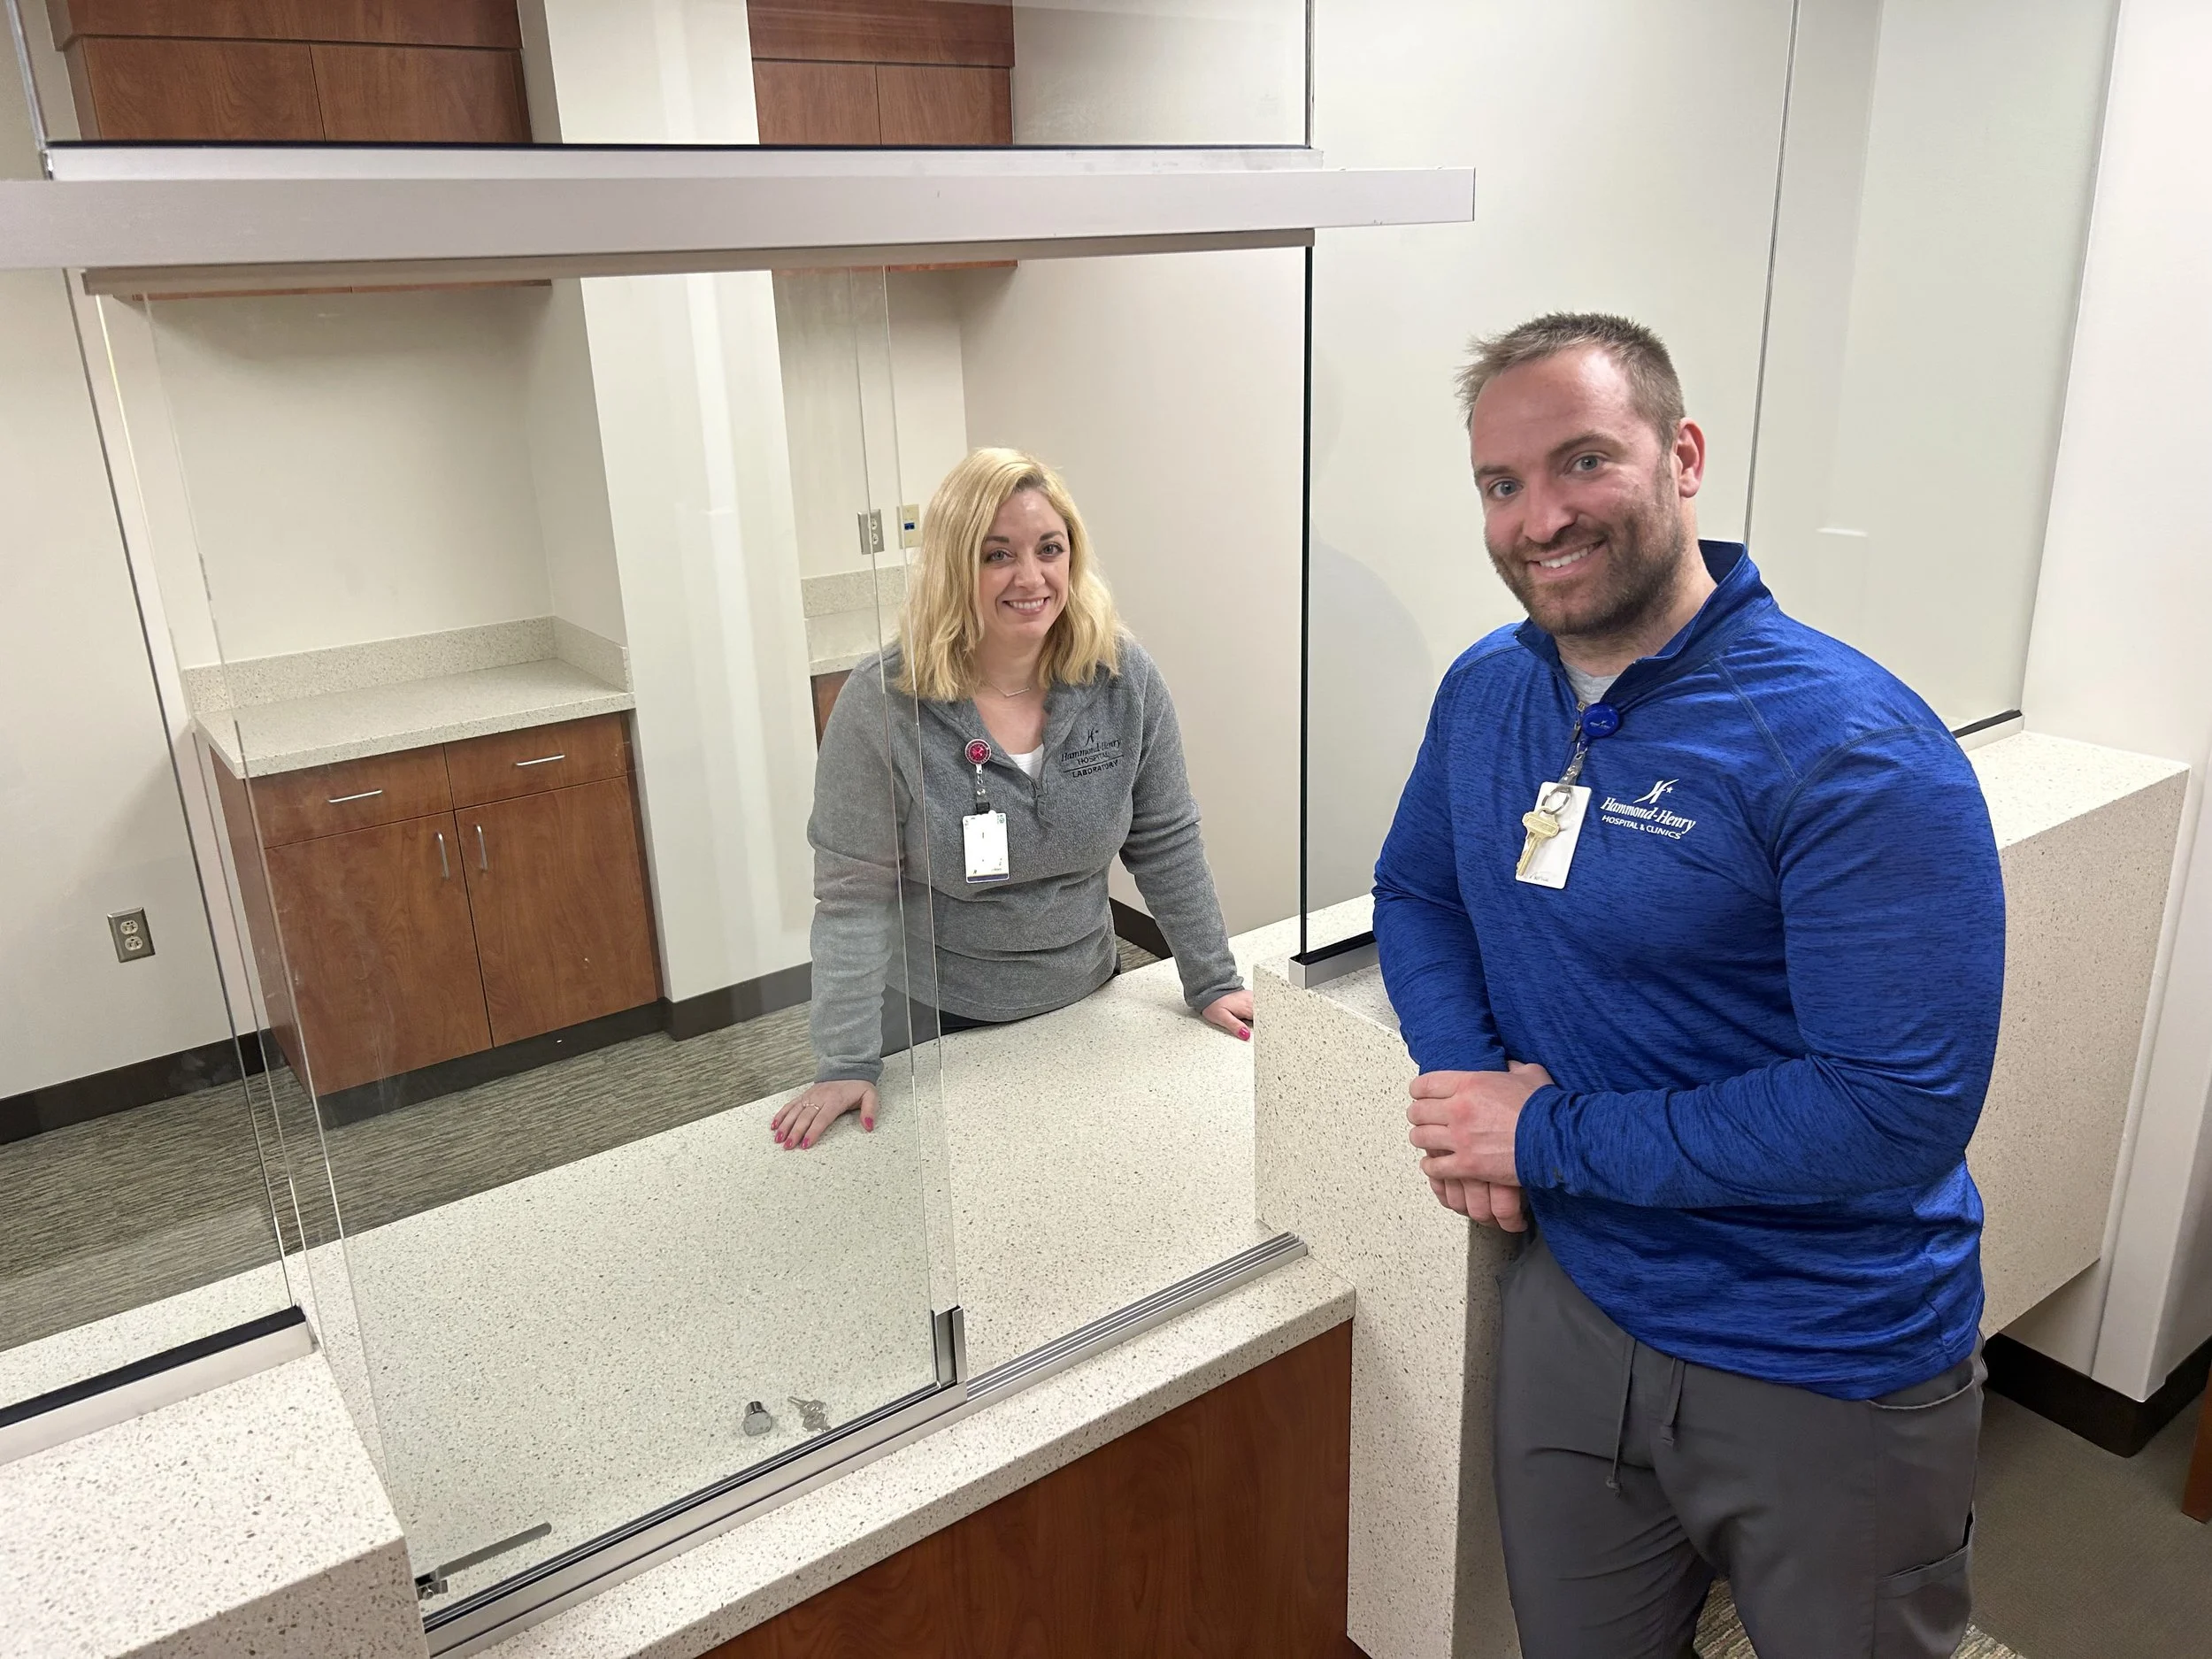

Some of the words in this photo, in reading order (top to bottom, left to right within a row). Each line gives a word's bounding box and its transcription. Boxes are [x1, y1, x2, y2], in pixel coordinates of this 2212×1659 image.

[1072, 759, 1118, 778] LABORATORY
[1601, 796, 1696, 834] Hammond-Henry
[1601, 815, 1639, 830] HOSPITAL
[1646, 825, 1682, 840] CLINICS
